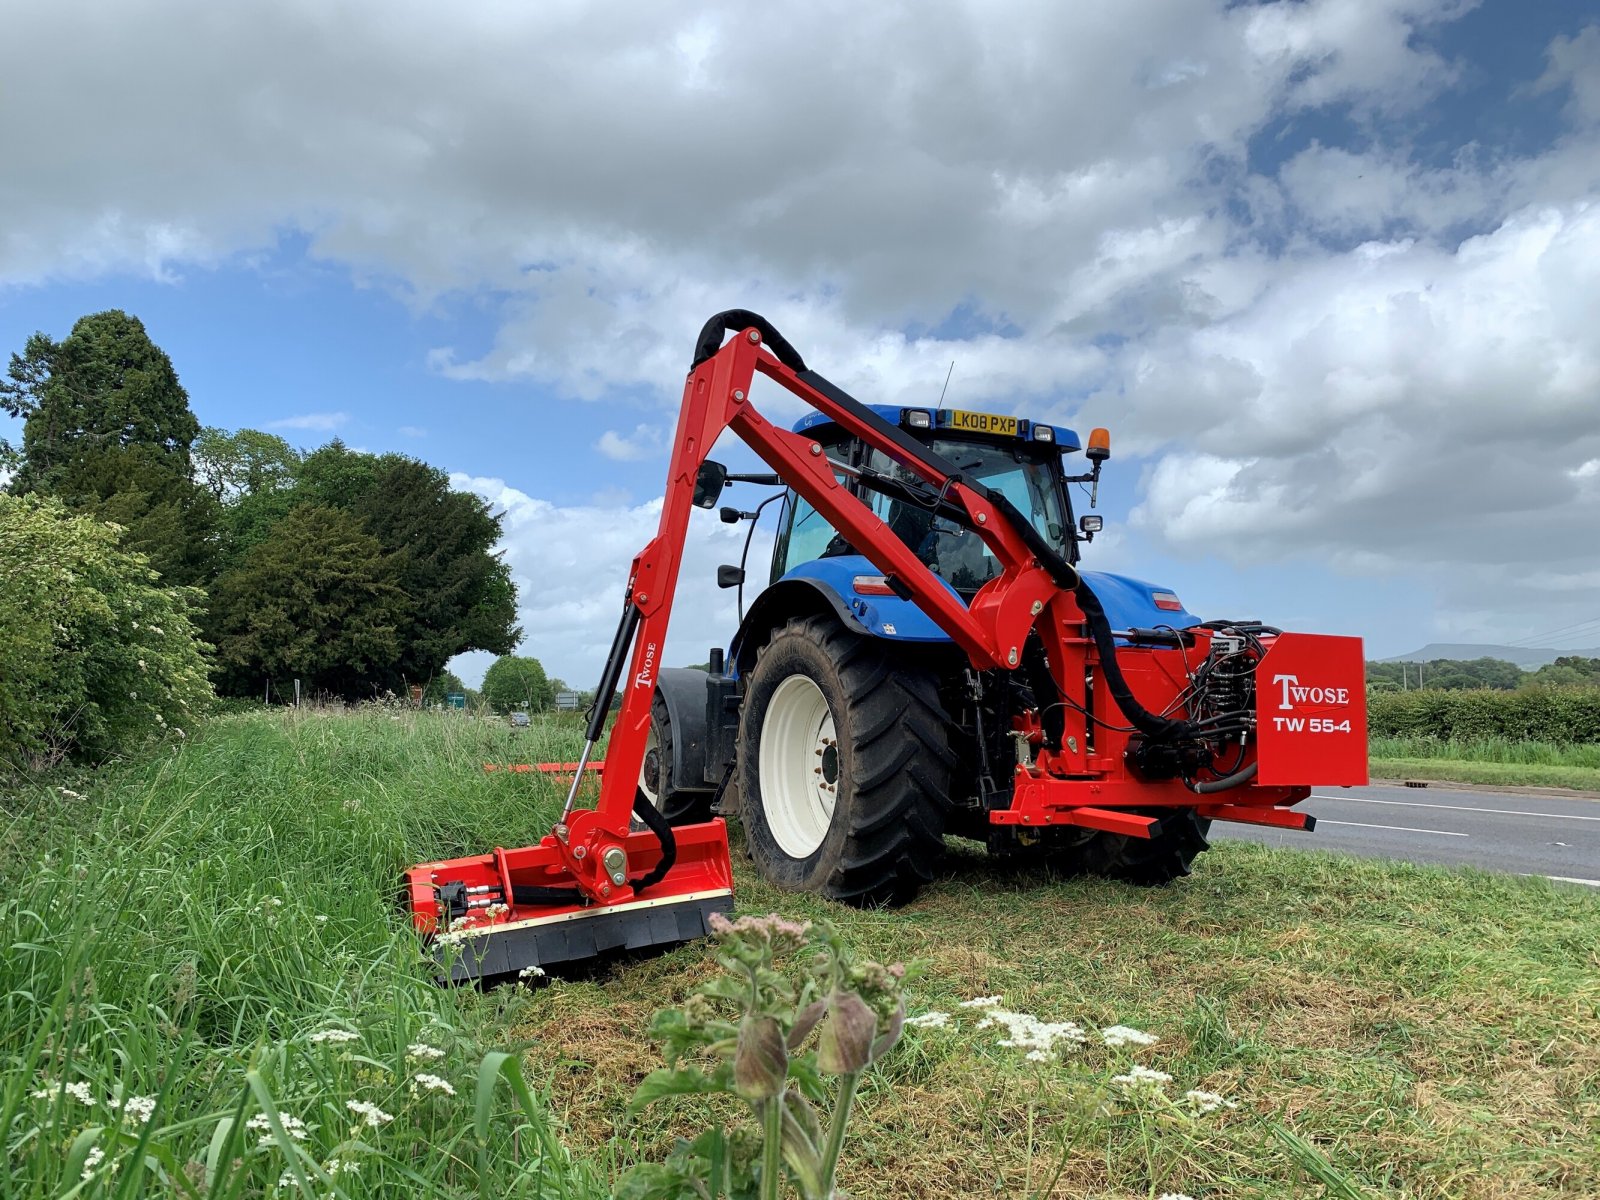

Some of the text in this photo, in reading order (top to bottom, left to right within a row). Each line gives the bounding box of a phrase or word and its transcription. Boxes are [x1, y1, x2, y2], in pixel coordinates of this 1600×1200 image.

[953, 411, 1016, 432] LK08 PXP
[1272, 717, 1351, 733] TW 55-4
